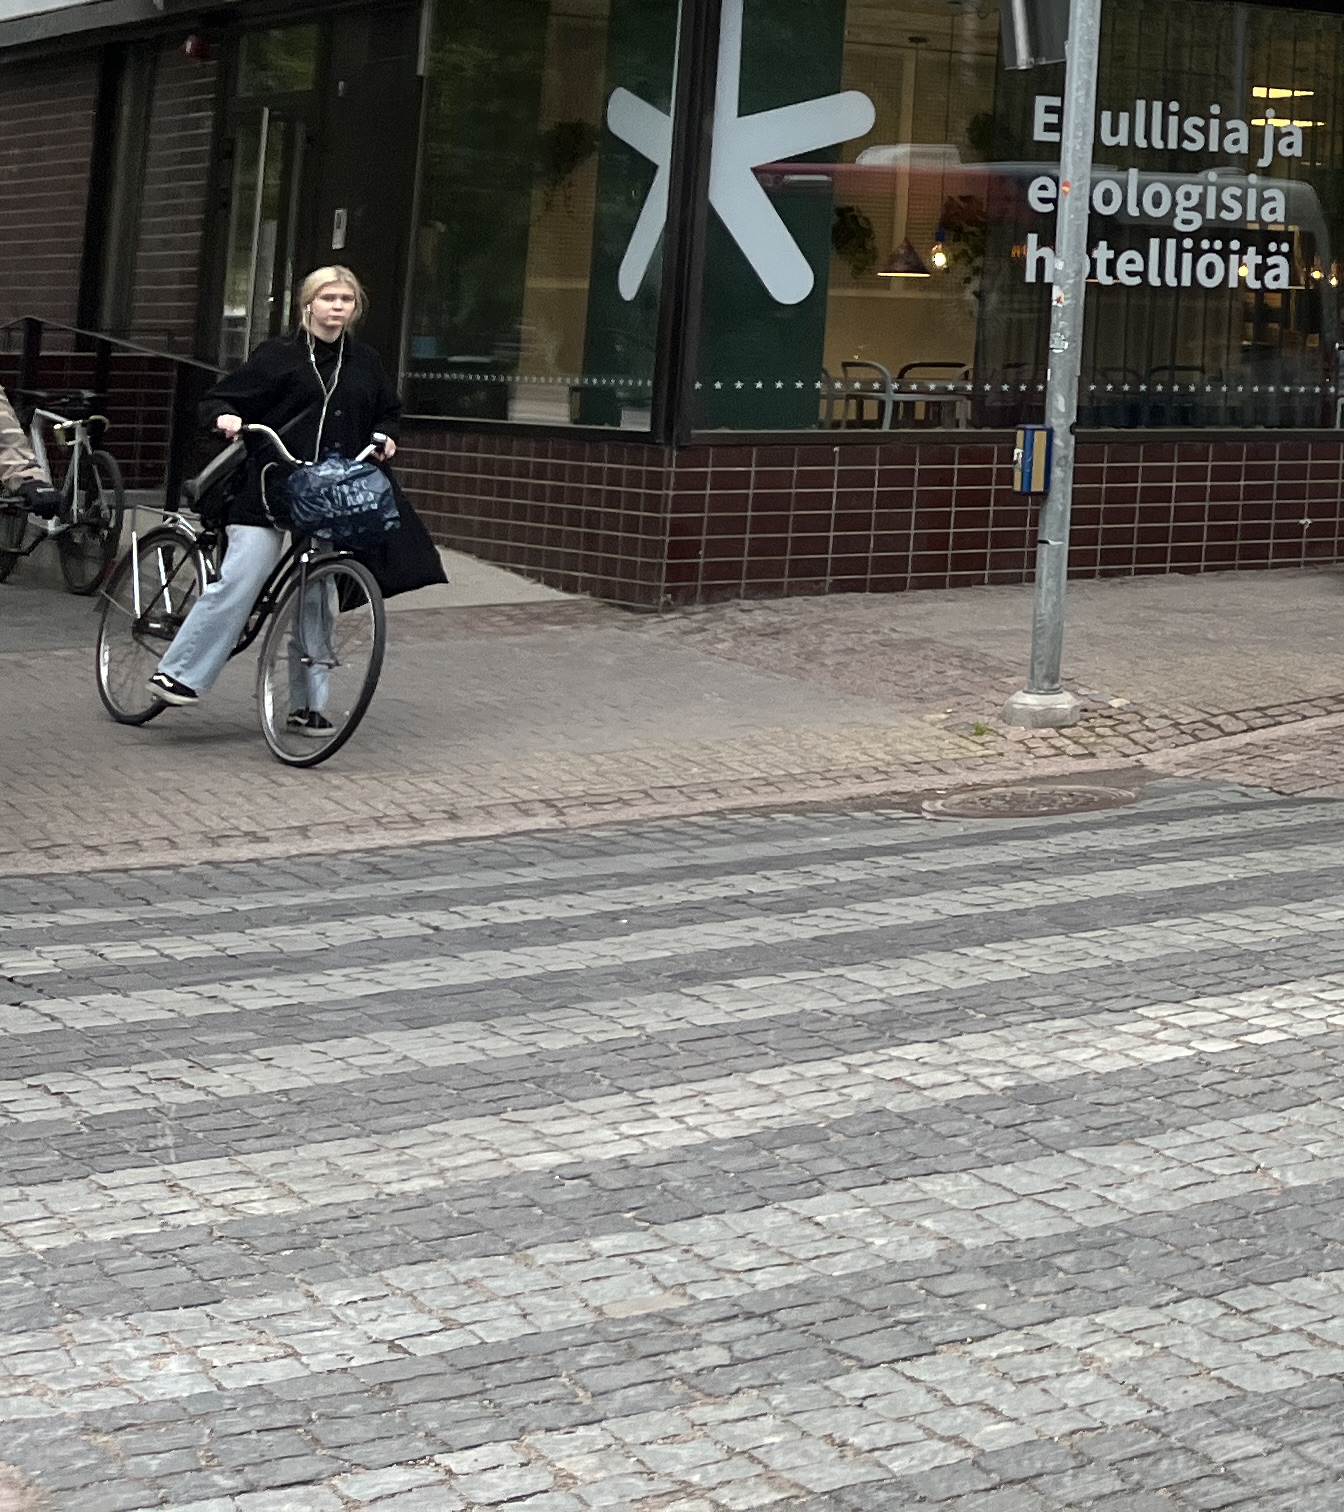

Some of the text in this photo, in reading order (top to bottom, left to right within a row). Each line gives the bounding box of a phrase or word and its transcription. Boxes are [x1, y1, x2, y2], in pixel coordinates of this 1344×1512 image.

[1034, 95, 1303, 168] Eullisia ja
[1027, 168, 1286, 232] eologisia
